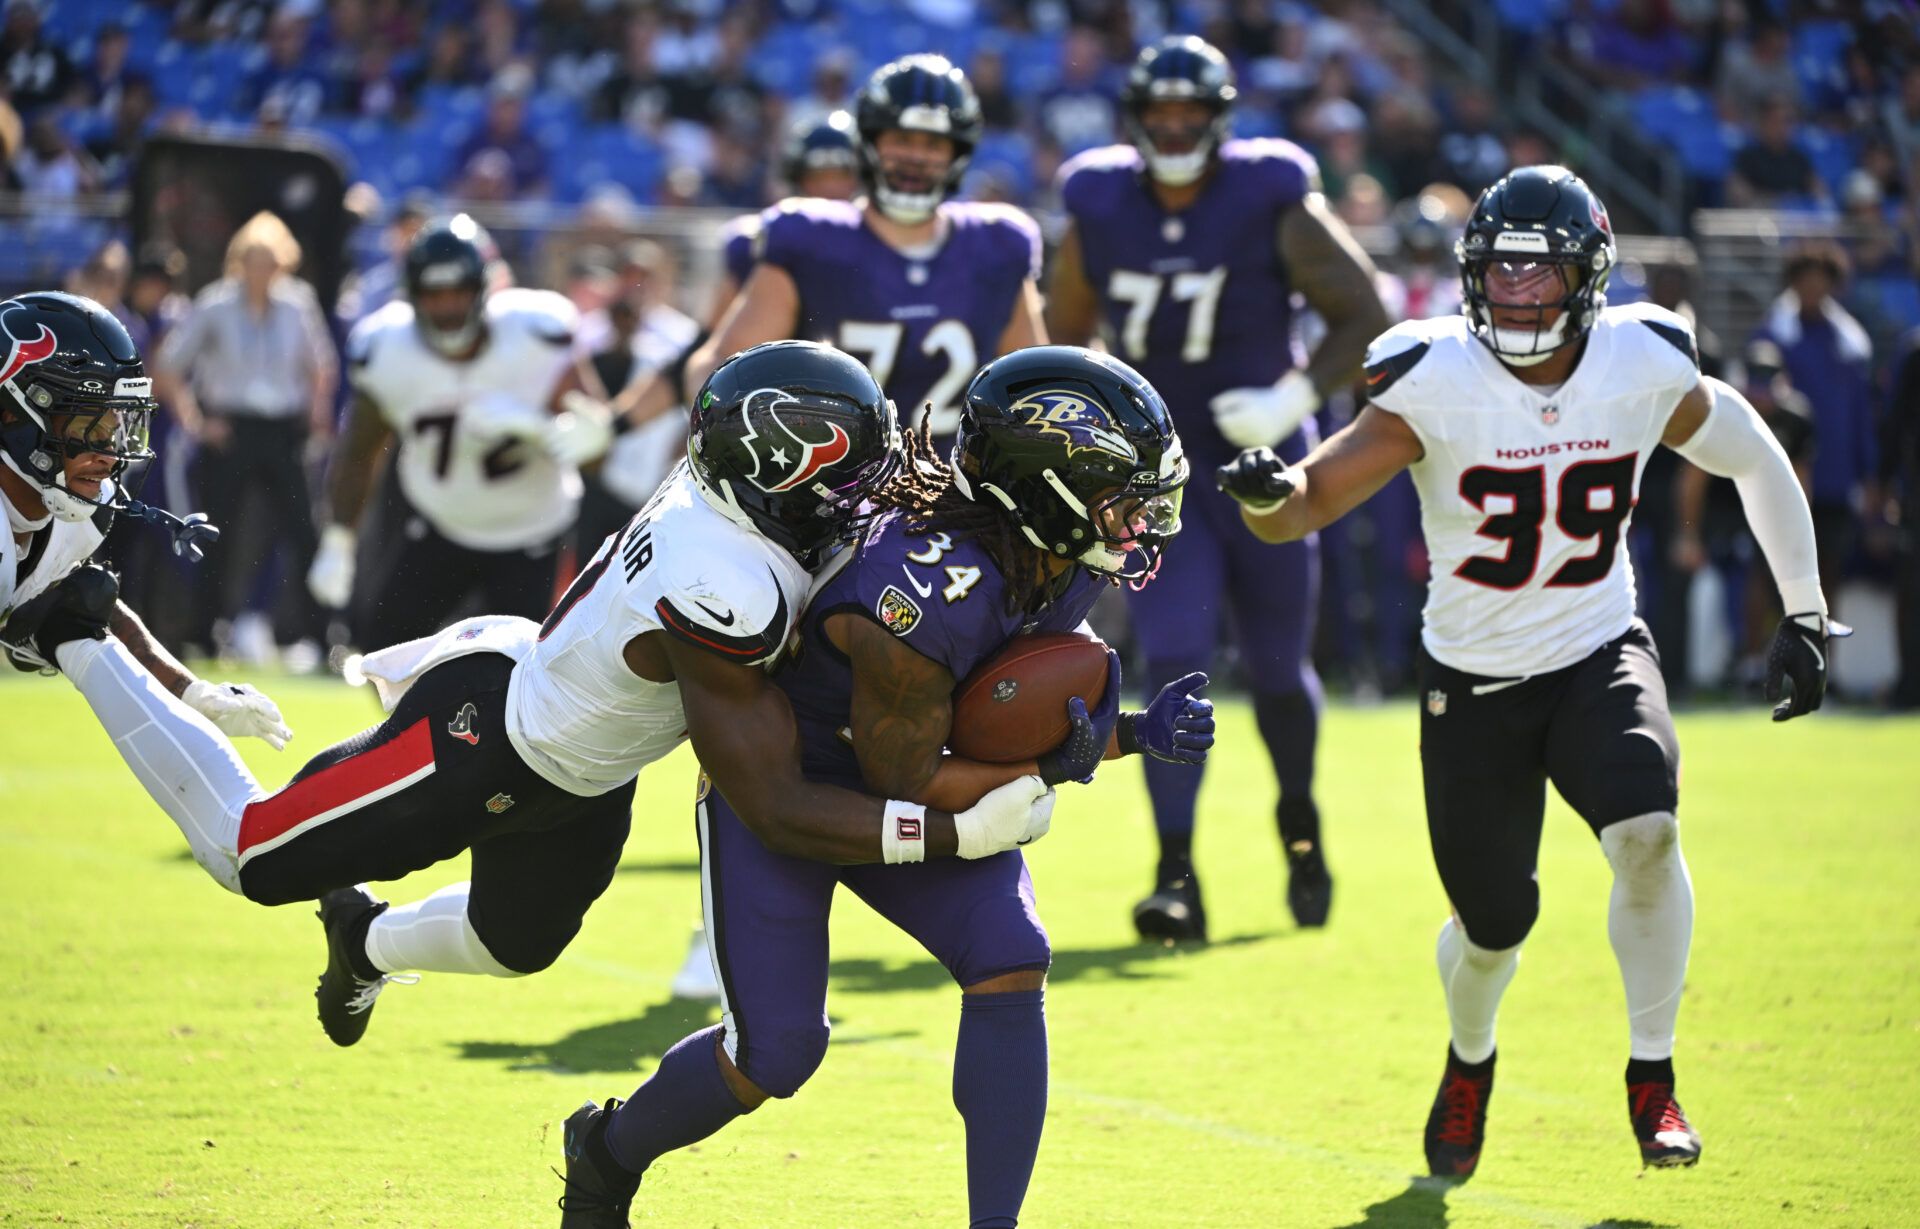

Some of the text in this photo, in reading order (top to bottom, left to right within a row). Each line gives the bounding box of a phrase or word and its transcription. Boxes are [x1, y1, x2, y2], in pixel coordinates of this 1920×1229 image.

[1109, 264, 1229, 363] 77
[839, 319, 979, 436] 72
[1496, 440, 1610, 459] HOUSTON
[1452, 450, 1639, 592] 39
[889, 590, 917, 616] RAVENS
[906, 531, 982, 603] 34
